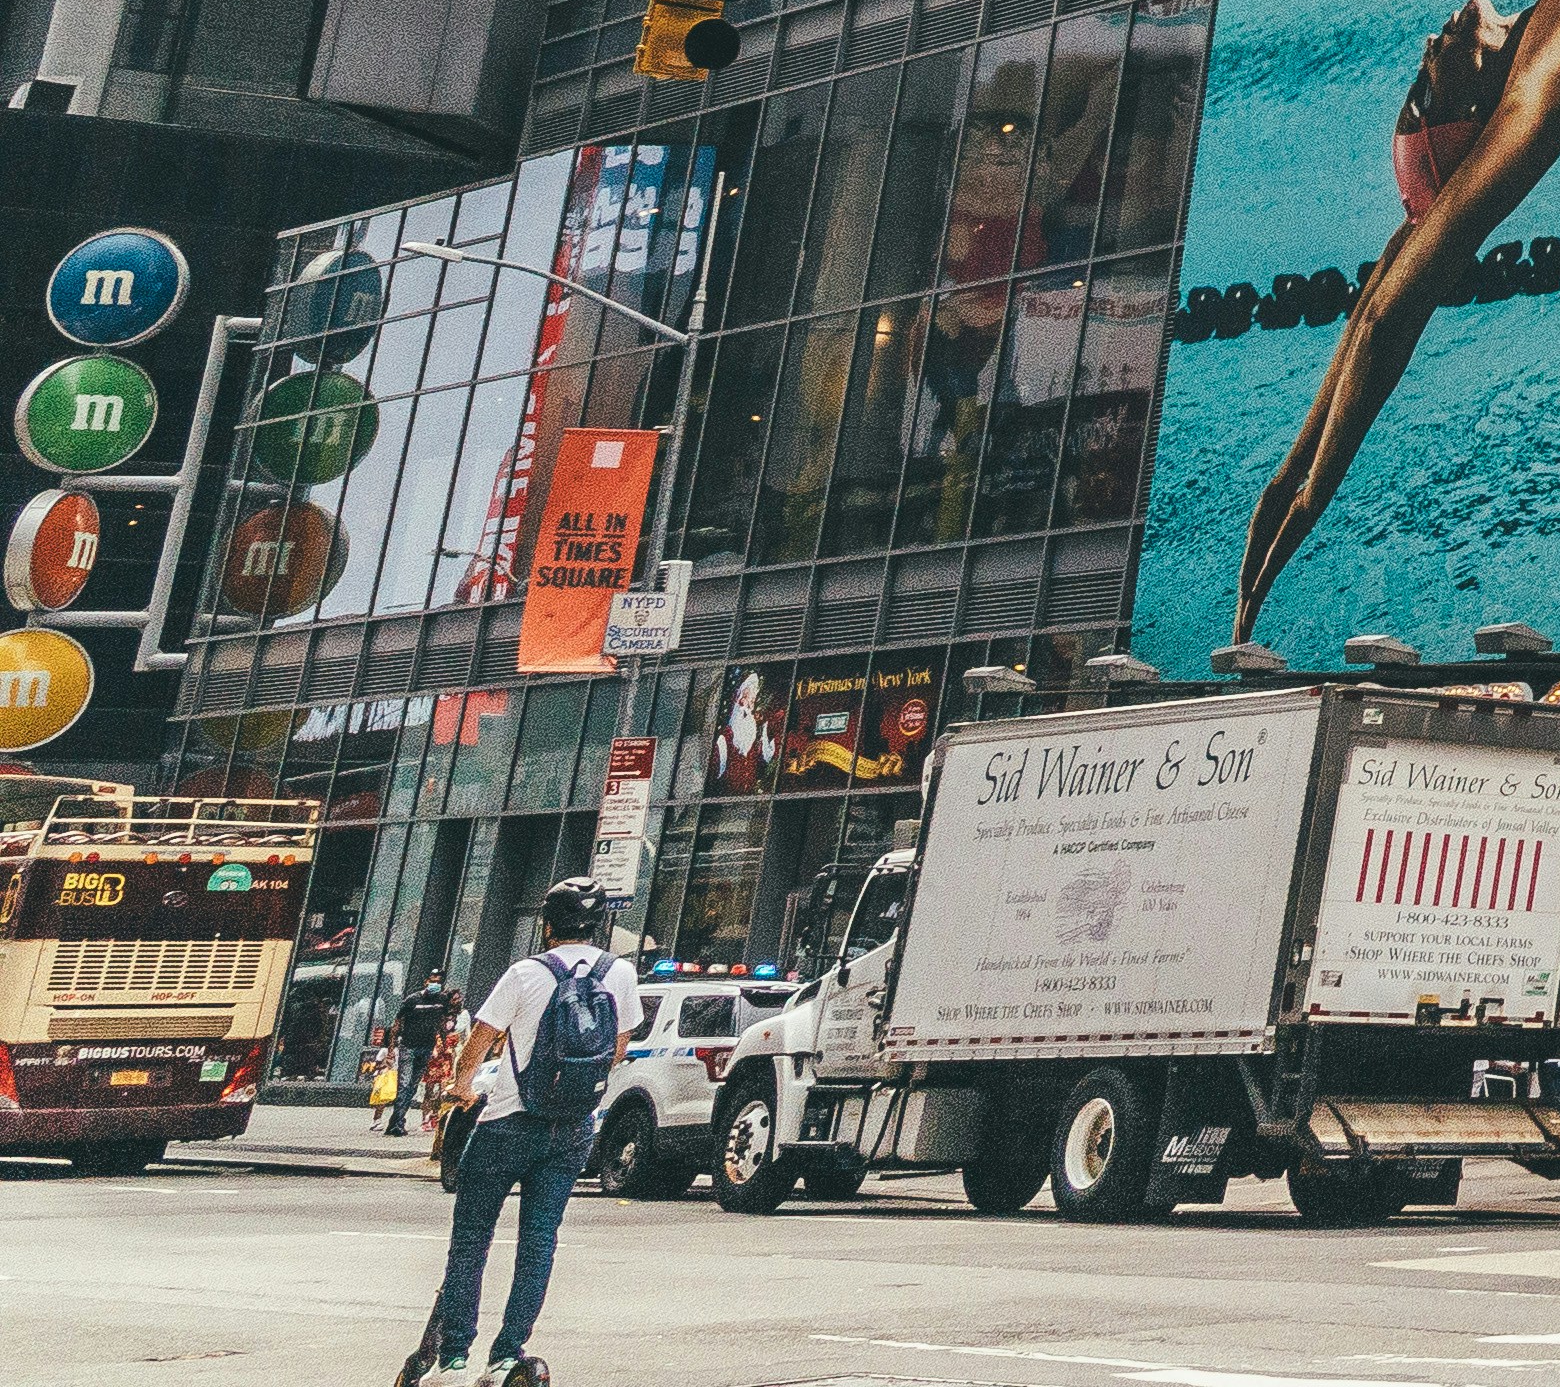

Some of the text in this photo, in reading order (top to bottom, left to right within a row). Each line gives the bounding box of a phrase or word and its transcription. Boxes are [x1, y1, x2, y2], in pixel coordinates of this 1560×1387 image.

[82, 267, 135, 305] m
[70, 391, 126, 433] m
[557, 512, 628, 532] ALL IN
[71, 529, 100, 570] m
[553, 539, 622, 563] TIMES
[536, 567, 628, 589] SQUARE
[621, 596, 666, 609] NYPD
[607, 625, 669, 639] SECURITY
[608, 638, 663, 650] CAMERA
[977, 739, 1188, 806] Sid Wainer &
[1358, 758, 1522, 797] Sid Wainer &
[608, 781, 619, 795] 3
[1363, 808, 1560, 838] Exclusive Distributors of Valley
[600, 841, 609, 853] 6
[1120, 839, 1157, 853] Company
[64, 873, 101, 889] BIG
[270, 879, 289, 889] 104
[56, 891, 96, 906] BUS
[1395, 910, 1510, 929] 1-800-423-8333
[1364, 930, 1534, 950] SUPPORT YOUR LOCAL FARMS
[1033, 950, 1149, 971] From Finest
[1349, 945, 1543, 969] SHOP WHERE THE CHEFS SHOP
[1033, 975, 1118, 993] 1-800-423-8333
[1377, 968, 1511, 986] WWW.SIDWAINER.COM
[53, 991, 198, 1002] HOP-ON HOP-OFF
[936, 997, 1215, 1022] SHOP WHERE THE CHEFS SHOP WWW.SIDWAINER.COM
[77, 1045, 207, 1060] BIGBUSTOURS.COM
